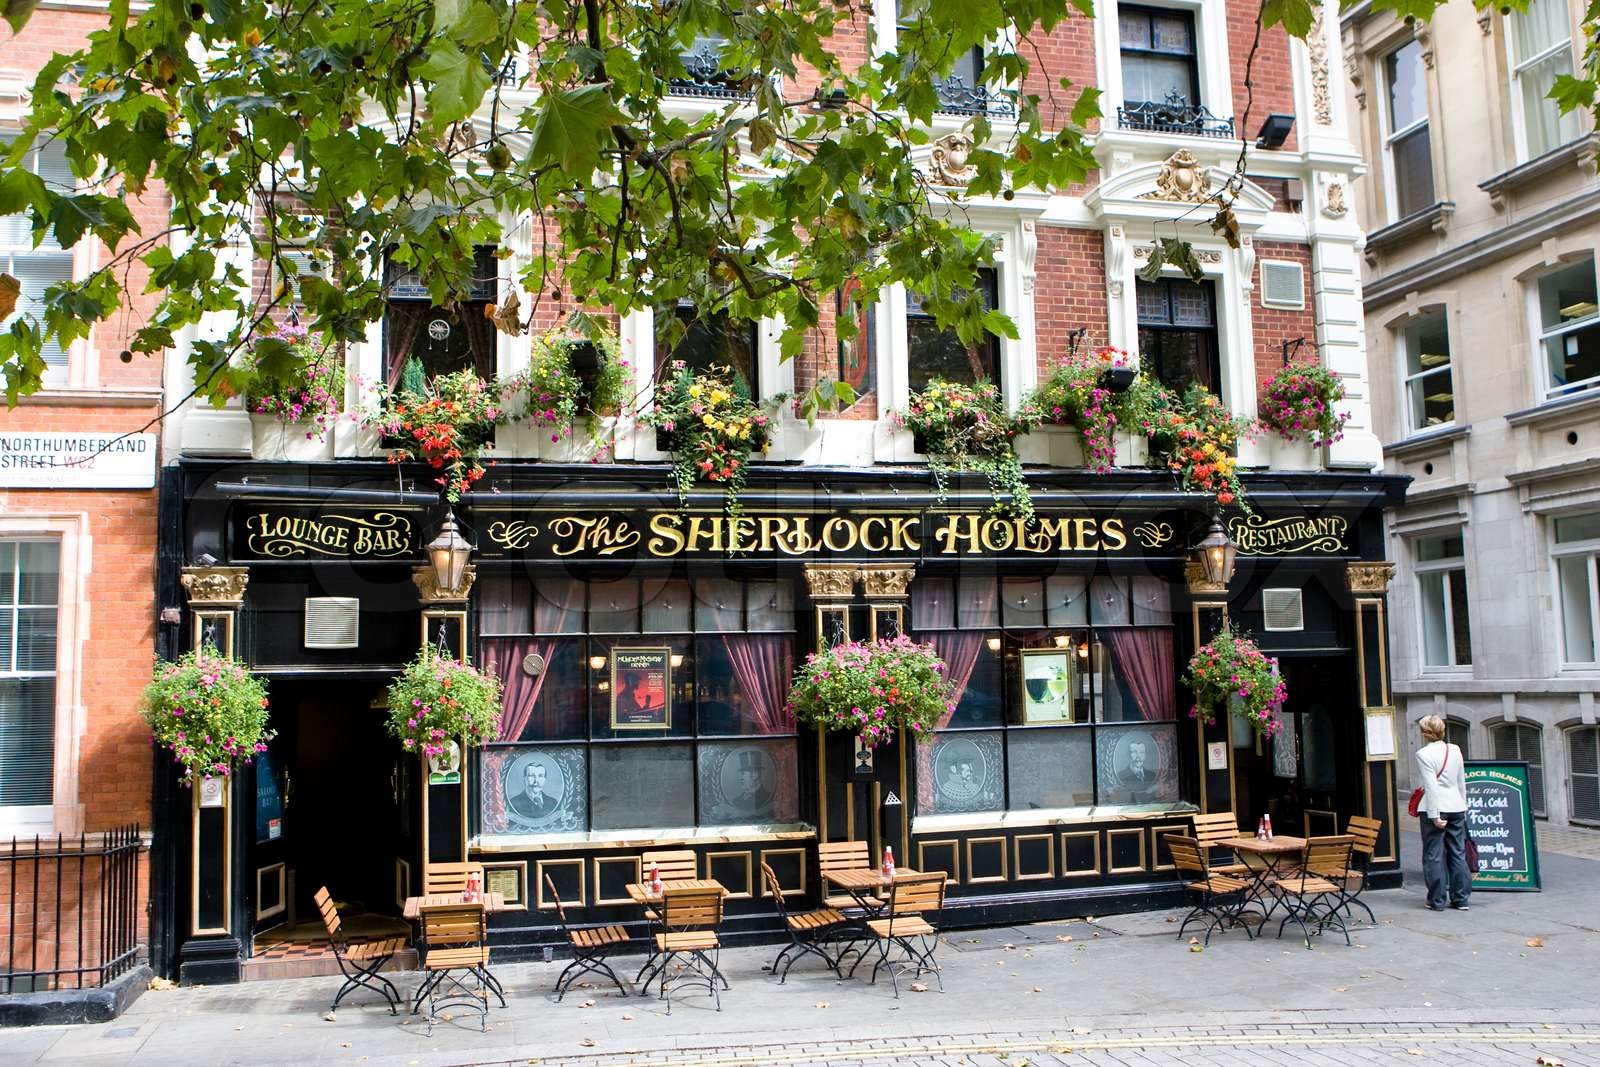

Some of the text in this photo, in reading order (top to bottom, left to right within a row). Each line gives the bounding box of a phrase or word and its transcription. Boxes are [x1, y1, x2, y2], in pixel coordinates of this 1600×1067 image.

[1, 438, 147, 453] NORTHUMBERLAND
[1, 455, 96, 469] STREET WC2
[259, 513, 403, 555] LOUNGE BAR
[548, 513, 1127, 557] The SHERLOCK HOLMES
[1236, 517, 1340, 549] RESTAURANT
[1464, 770, 1523, 786] LOCK HOLMES
[1467, 796, 1484, 808] Hot
[1488, 796, 1509, 808] Cold
[1467, 809, 1505, 825] Food
